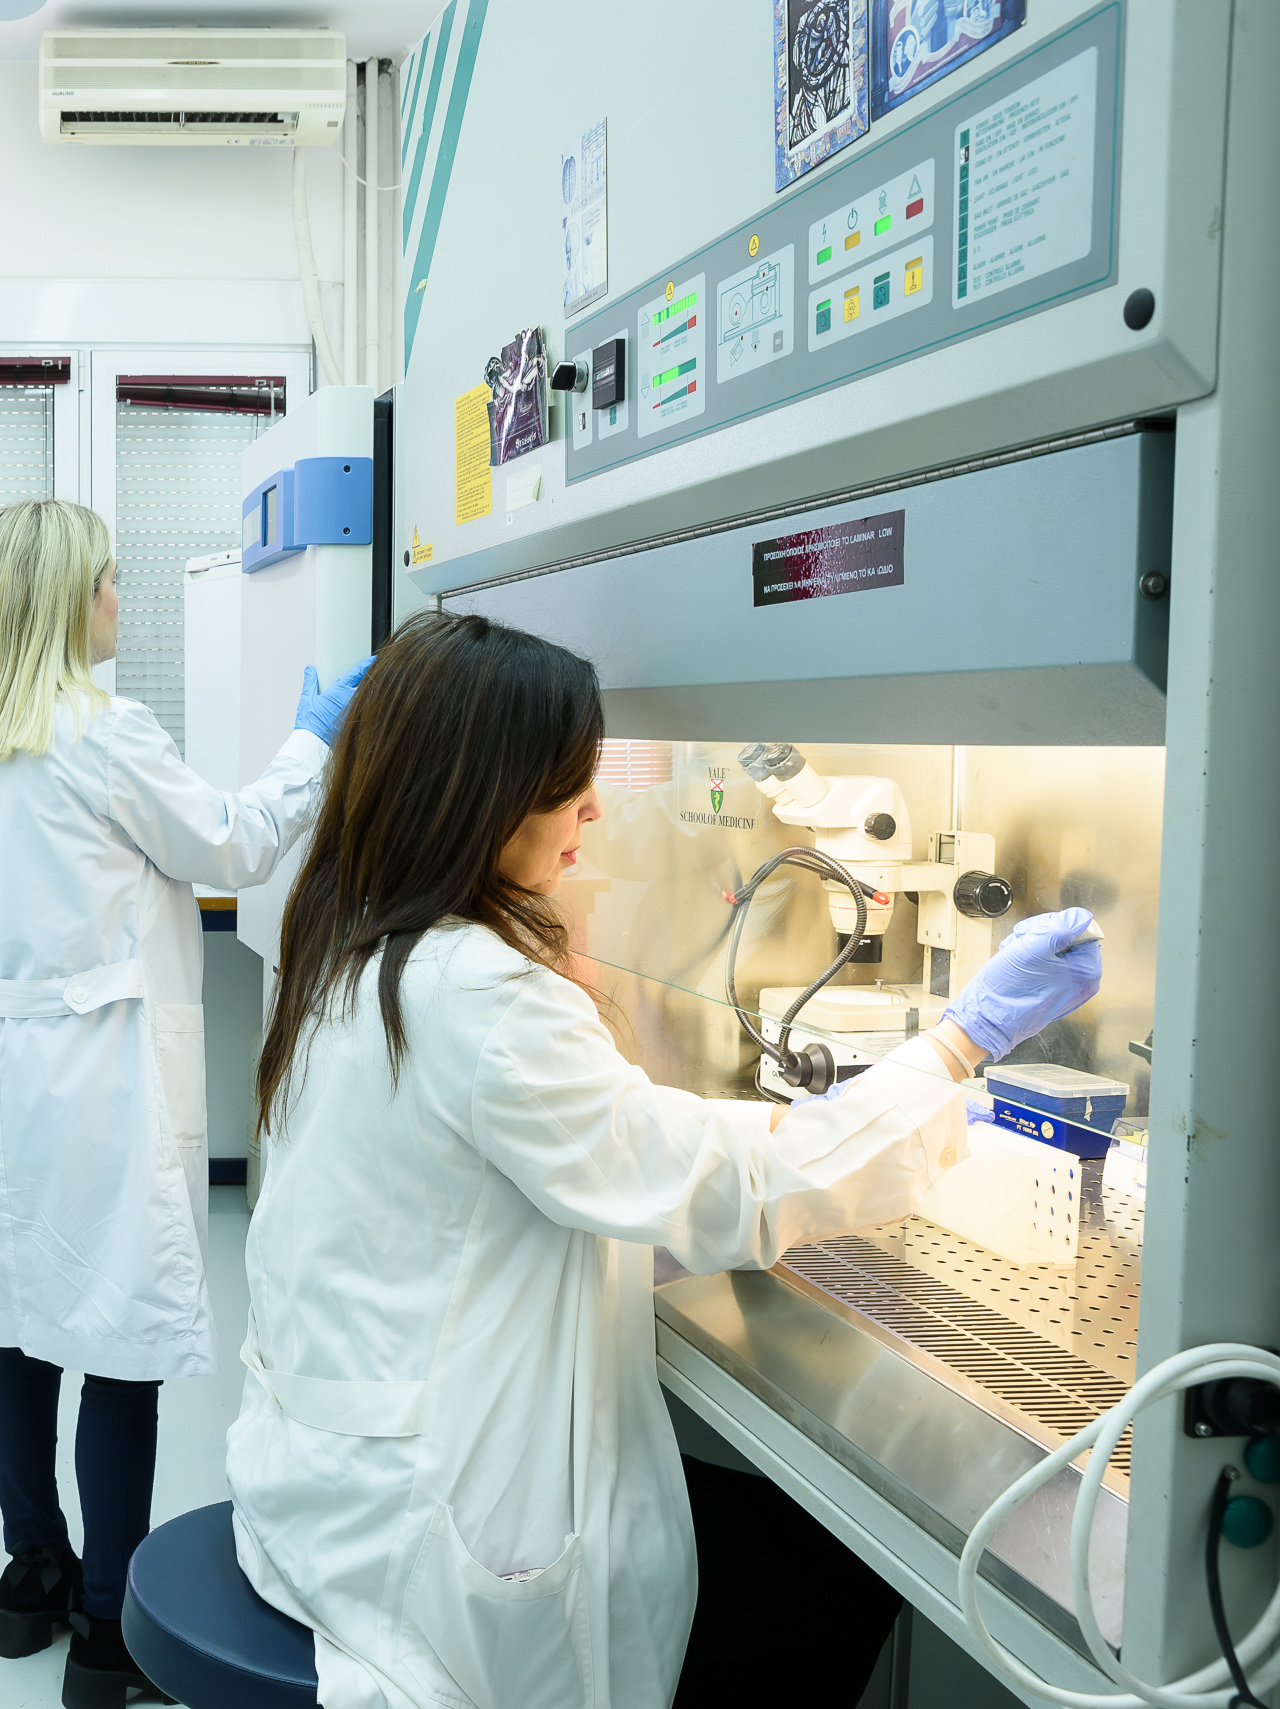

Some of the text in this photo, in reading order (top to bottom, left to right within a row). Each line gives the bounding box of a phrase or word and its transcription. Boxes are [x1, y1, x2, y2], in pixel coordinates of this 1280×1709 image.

[516, 432, 536, 449] Brussels
[850, 530, 874, 544] LAMINAR
[708, 766, 726, 779] YALE
